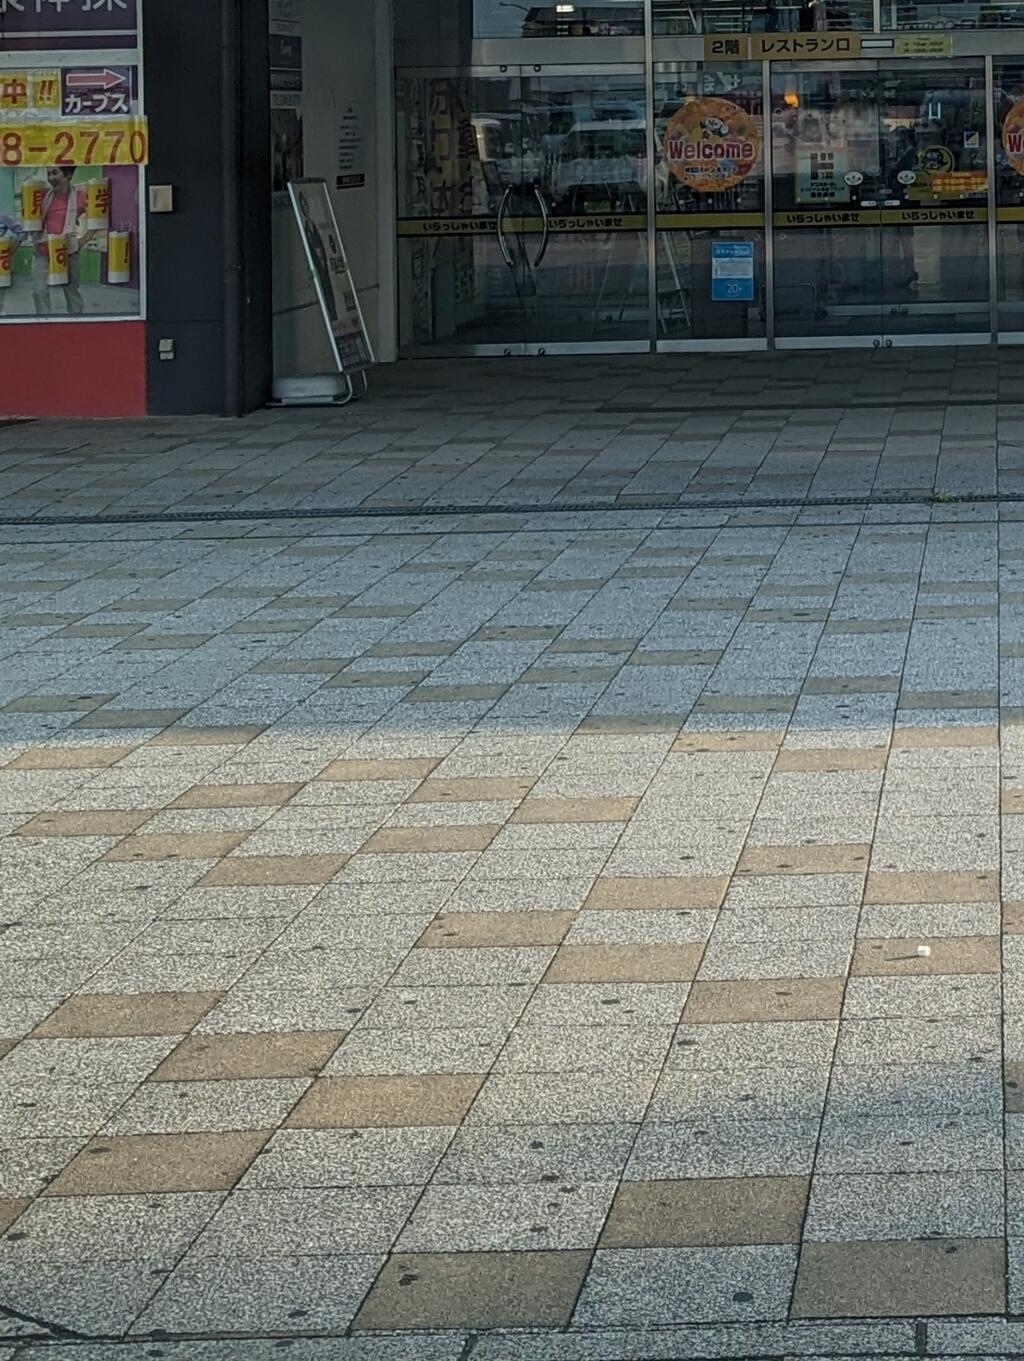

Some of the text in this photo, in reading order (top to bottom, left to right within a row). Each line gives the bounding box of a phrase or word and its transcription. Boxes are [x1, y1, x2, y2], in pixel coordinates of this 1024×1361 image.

[711, 37, 851, 55] 2階 レストラン口
[64, 93, 129, 114] カーブス
[2, 131, 145, 166] 8-2770
[669, 140, 754, 159] Welcome
[549, 217, 623, 229] いらっしゃいませ
[786, 213, 860, 222] いらっしゃいませ
[902, 211, 975, 220] いらっしゃいませ
[422, 219, 497, 231] いらっしゃいませ
